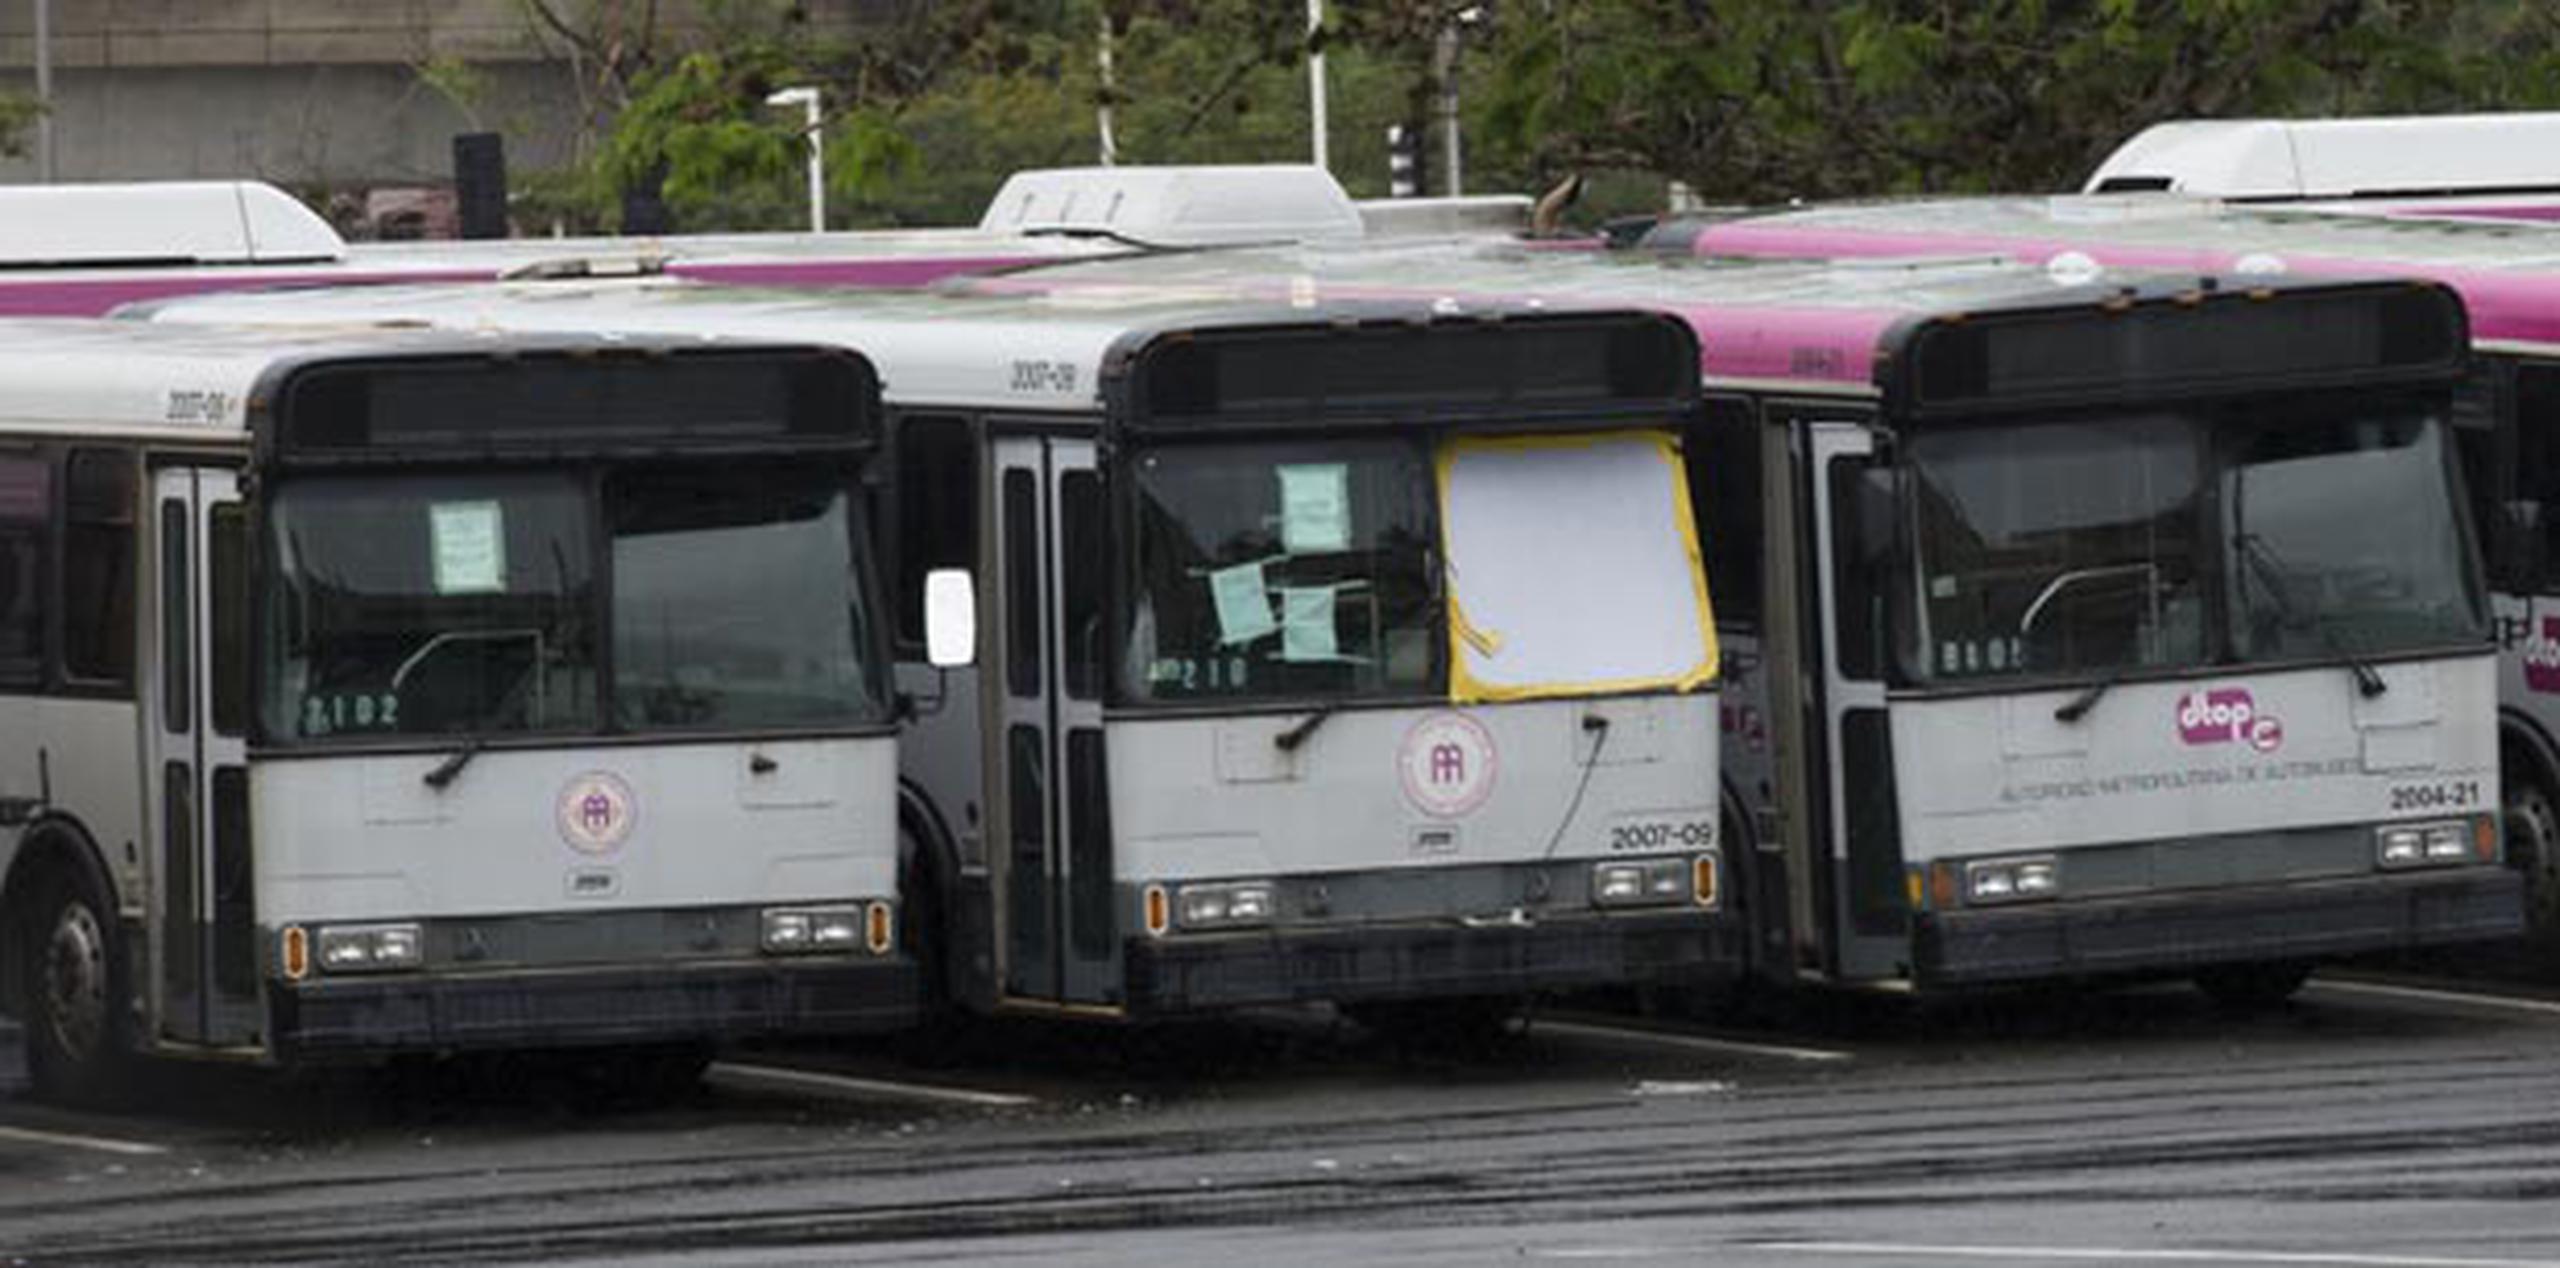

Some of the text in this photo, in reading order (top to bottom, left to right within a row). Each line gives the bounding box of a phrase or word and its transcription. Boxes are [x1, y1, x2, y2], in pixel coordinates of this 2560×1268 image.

[2181, 692, 2251, 741] dtop
[2390, 782, 2479, 810] 2004-21
[1611, 822, 1712, 850] 2007-09
